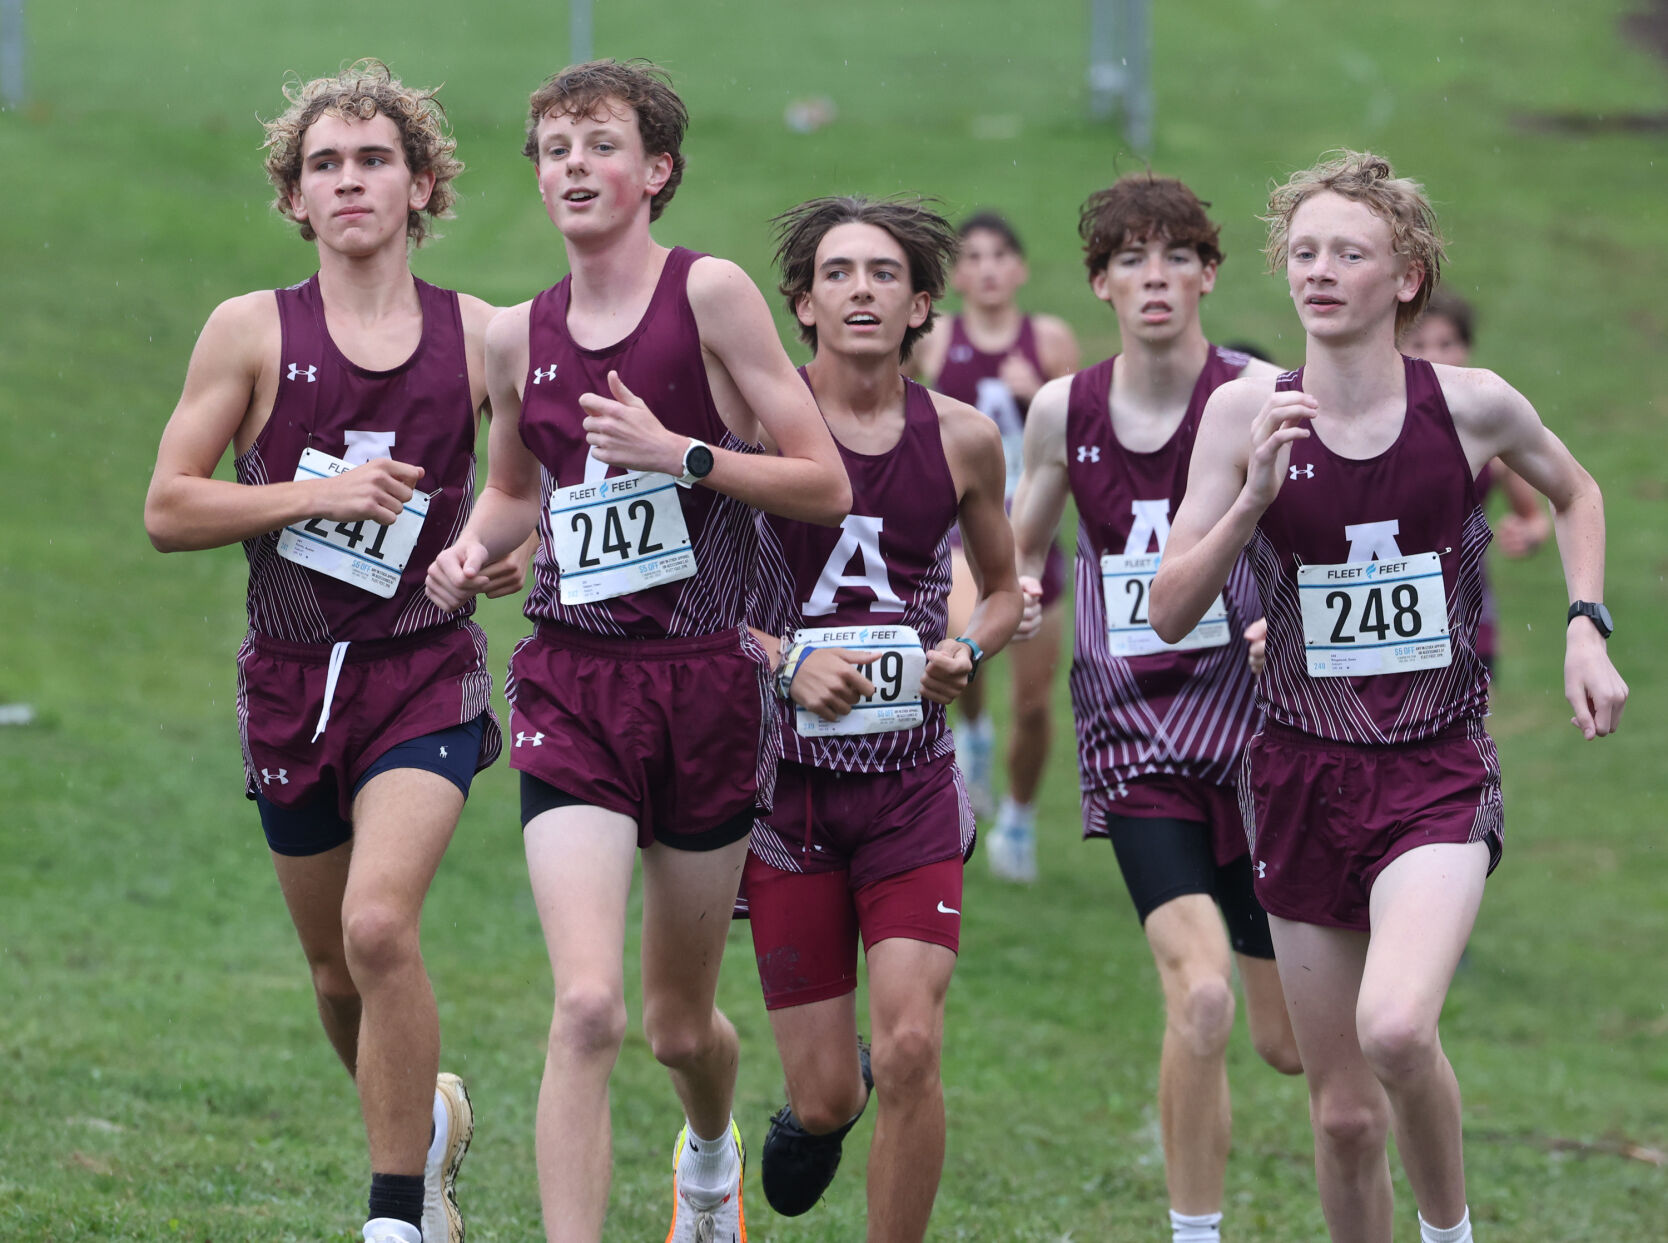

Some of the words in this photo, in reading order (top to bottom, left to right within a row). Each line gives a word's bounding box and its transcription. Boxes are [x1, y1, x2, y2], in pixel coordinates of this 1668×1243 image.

[569, 488, 597, 501] FLEET
[612, 478, 640, 493] FEET
[572, 501, 663, 568] 242
[801, 514, 907, 617] A
[1124, 558, 1151, 569] FLEET
[1327, 567, 1363, 579] FLEET
[1379, 562, 1408, 575] FEET
[1326, 585, 1422, 643] 248
[823, 632, 856, 642] FLEET
[871, 630, 898, 641] FEET
[1403, 646, 1415, 656] OFF
